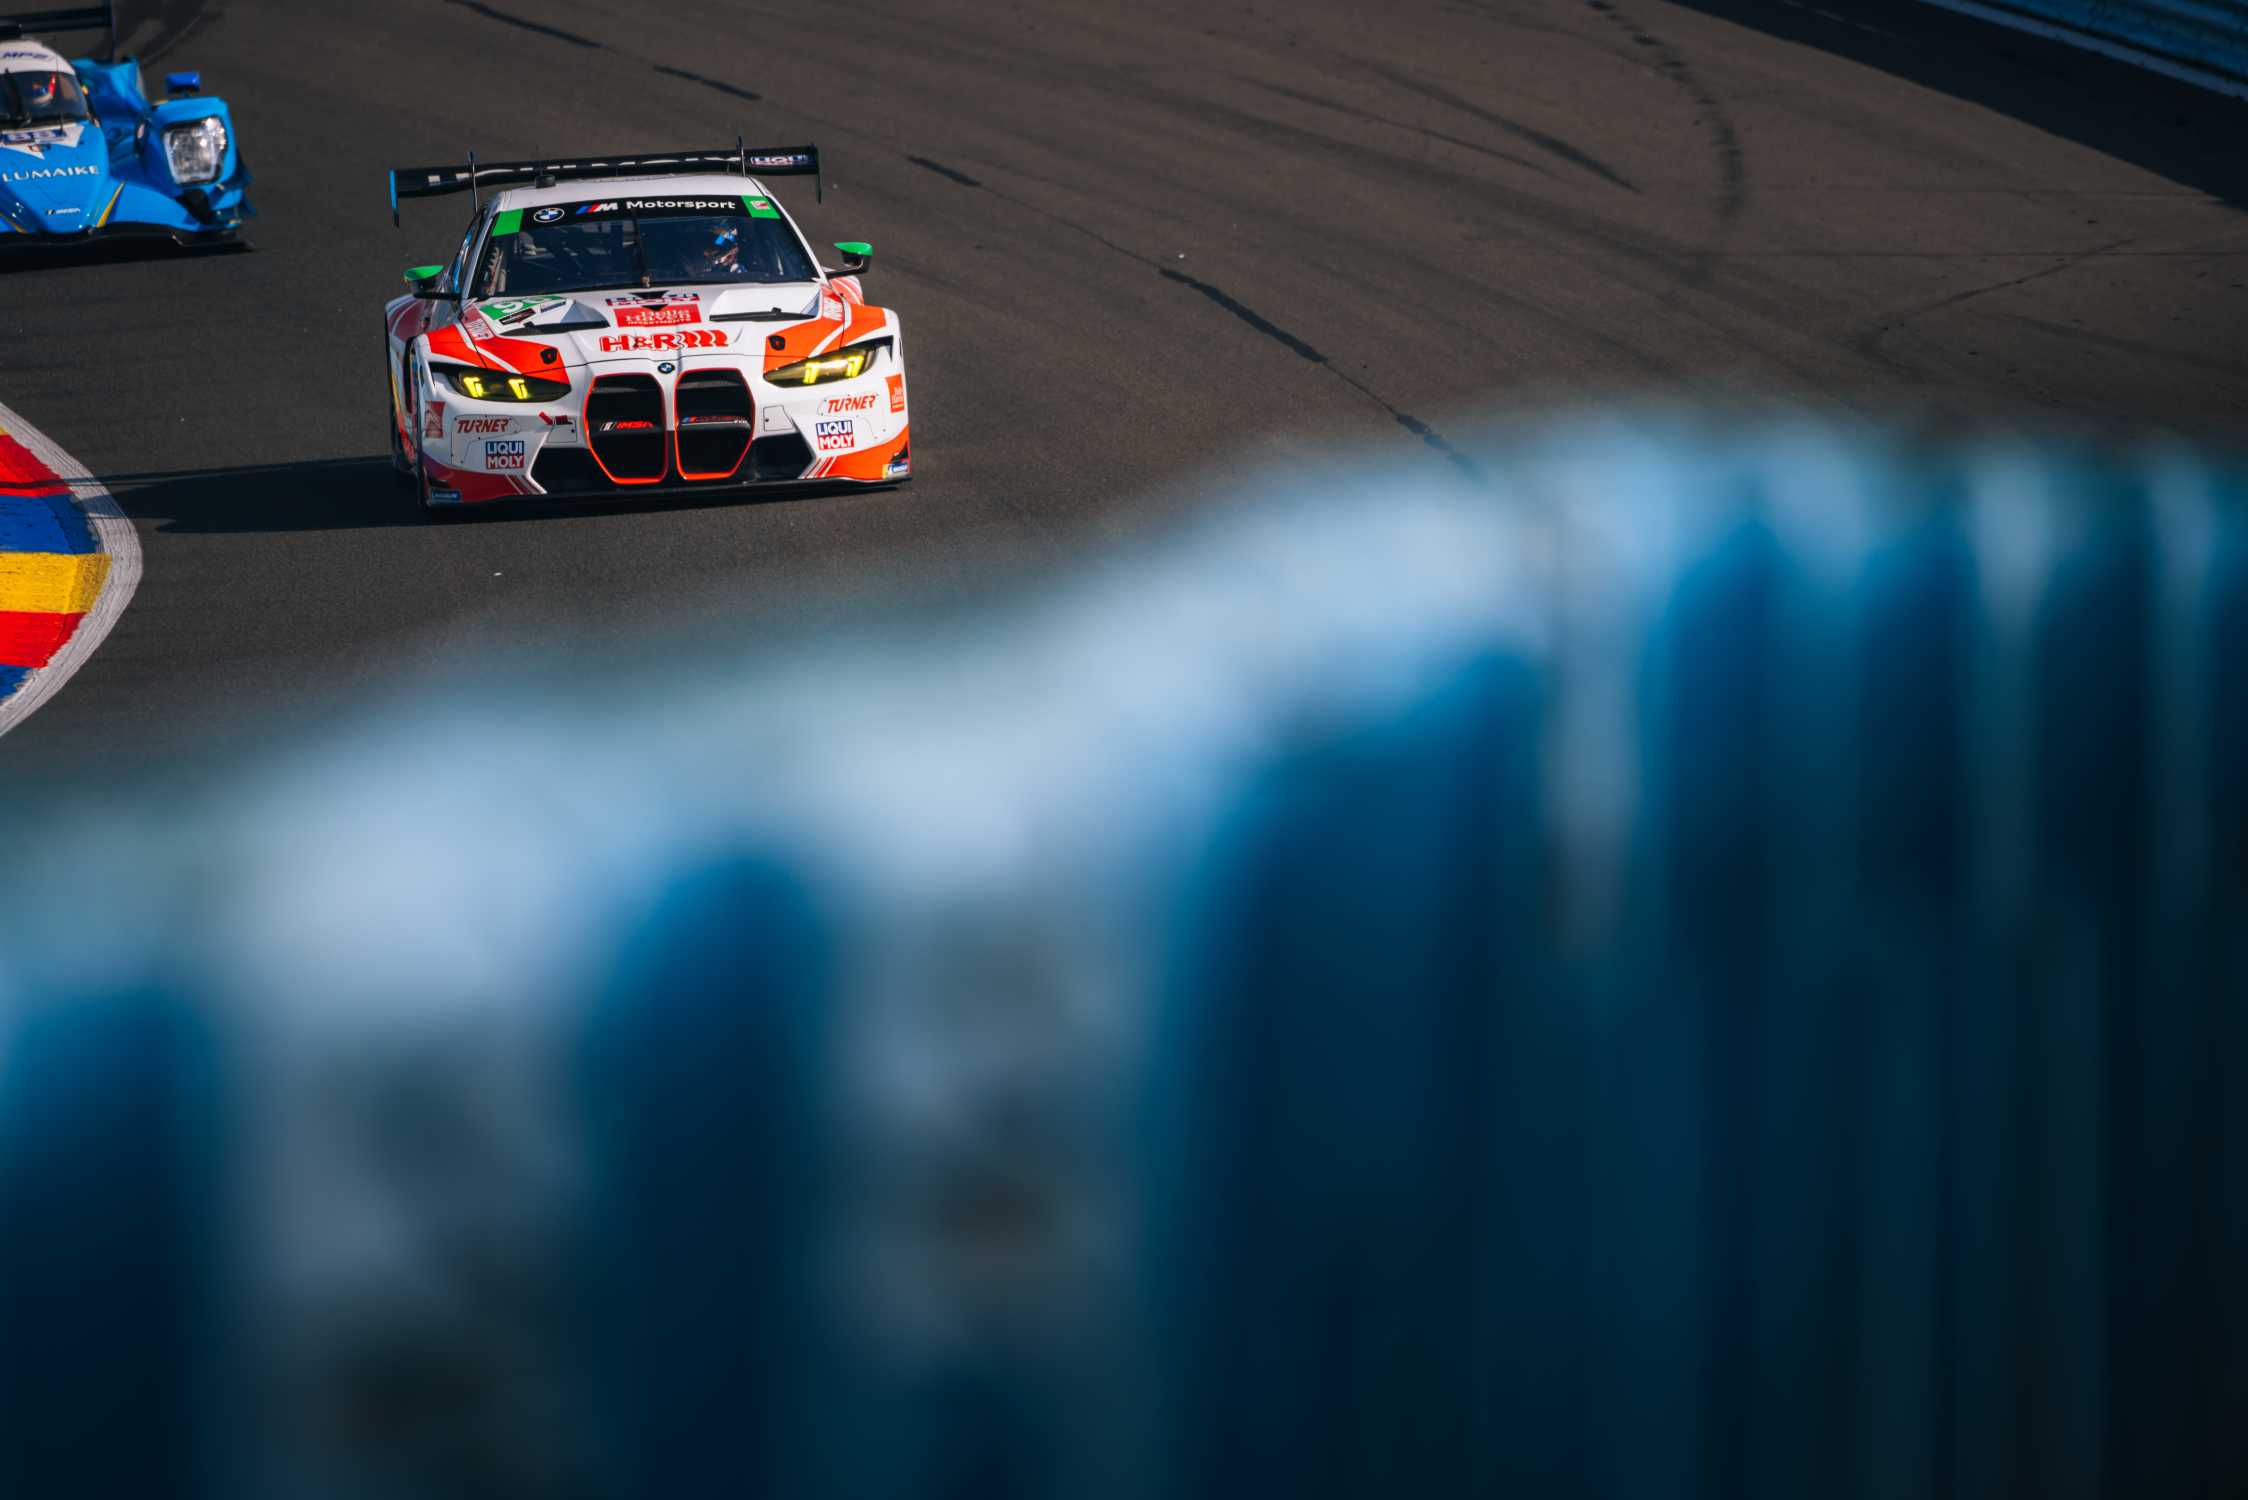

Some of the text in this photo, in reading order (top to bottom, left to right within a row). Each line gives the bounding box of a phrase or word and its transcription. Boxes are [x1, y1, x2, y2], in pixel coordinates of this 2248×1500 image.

[626, 199, 736, 212] Motorsport
[828, 395, 876, 414] TURNER
[457, 418, 510, 434] TURNER
[817, 422, 852, 436] LIQUI
[487, 442, 524, 455] LIQUI
[819, 435, 854, 449] MOLY
[487, 455, 524, 469] MOLY
